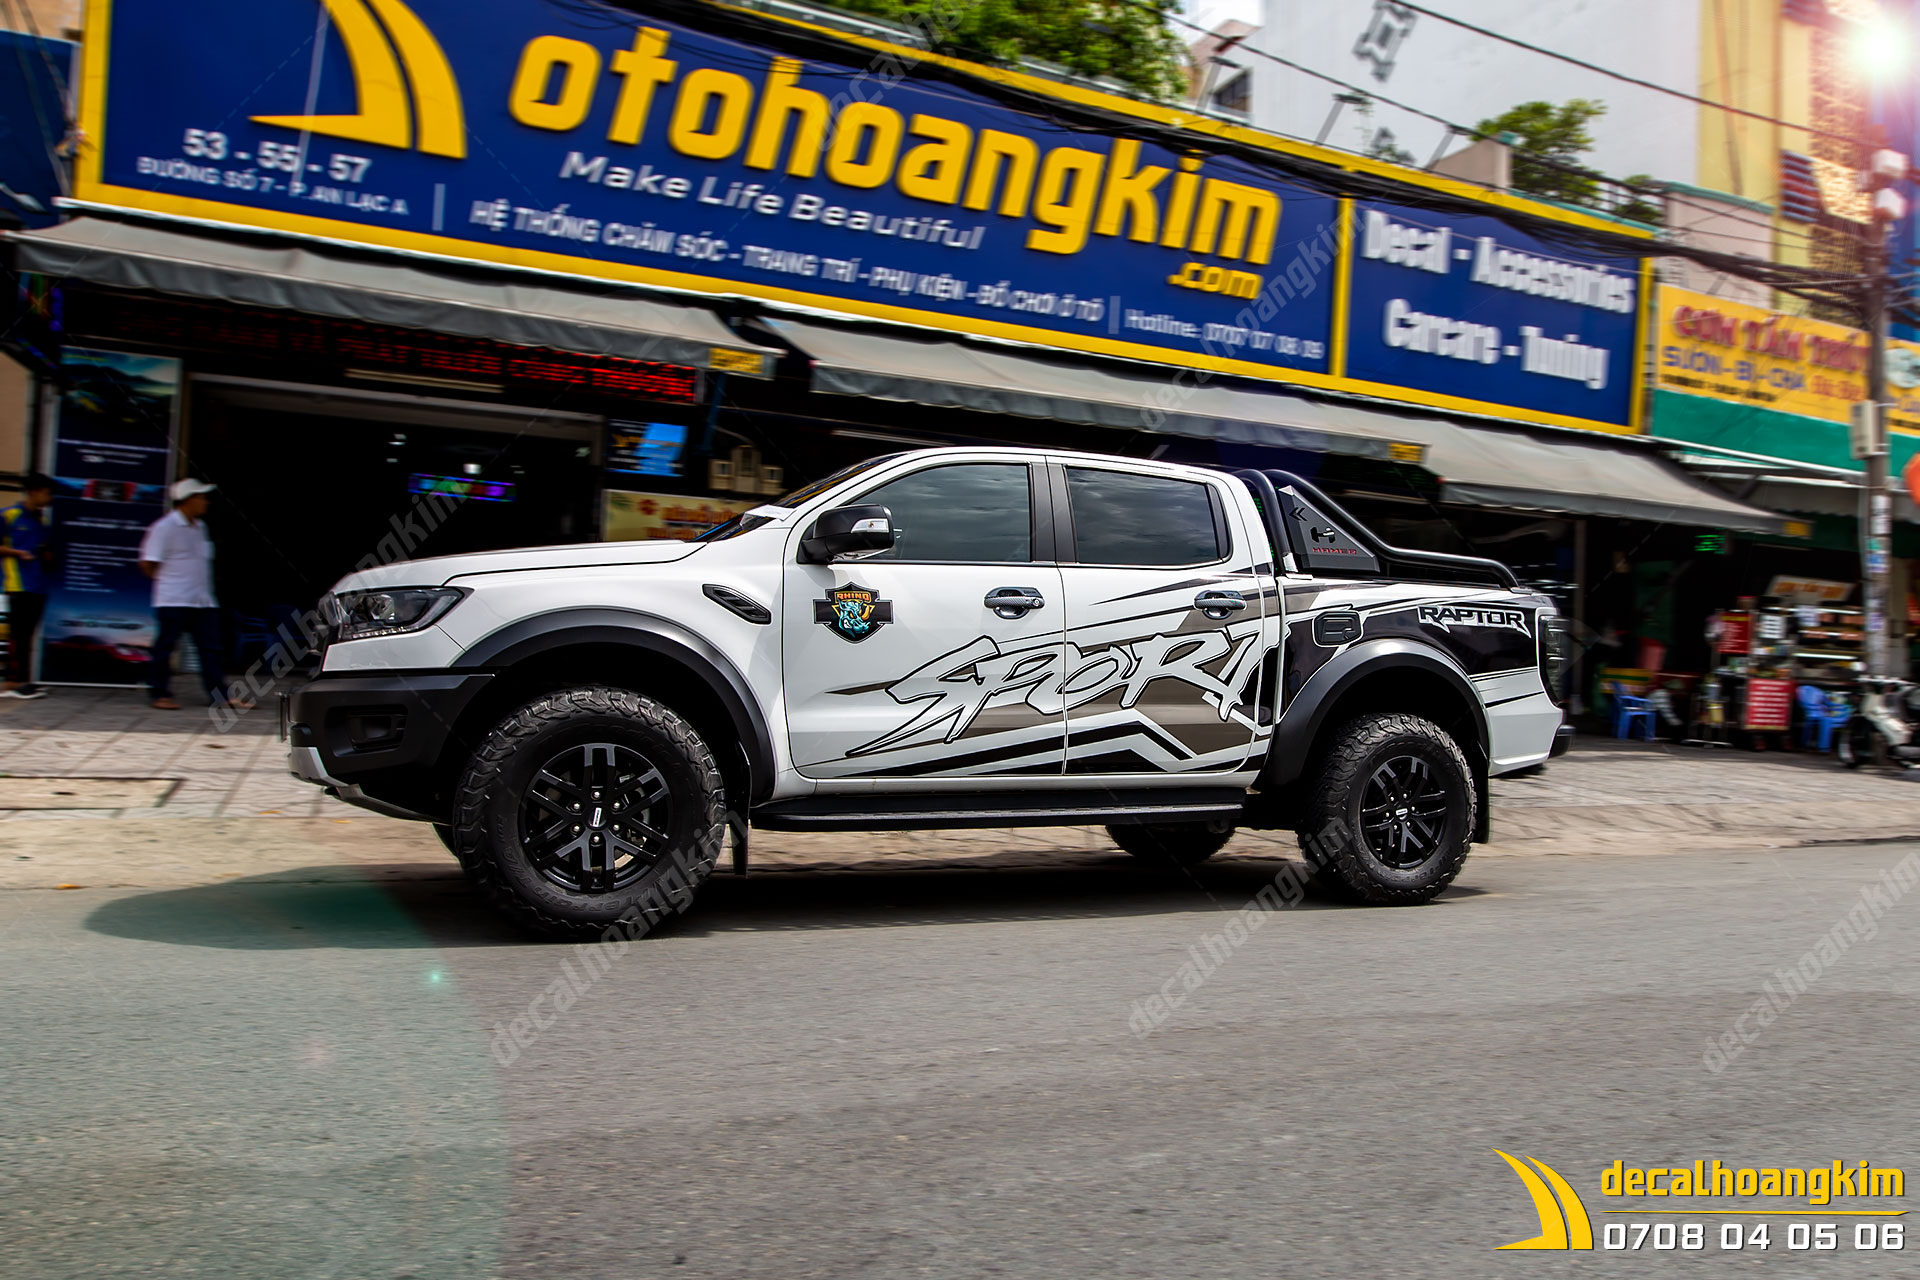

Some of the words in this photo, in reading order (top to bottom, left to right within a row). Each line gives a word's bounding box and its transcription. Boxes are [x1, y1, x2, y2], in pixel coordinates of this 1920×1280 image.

[183, 128, 228, 160] 53
[257, 140, 300, 172] 55
[328, 154, 372, 183] 57
[509, 27, 1282, 264] otohoangkim
[559, 151, 691, 198] Make
[697, 176, 784, 215] Life
[789, 193, 986, 250] Beautiful
[469, 199, 510, 231] HỆ
[513, 204, 601, 242] THỐNG
[602, 221, 677, 253] CHĂM
[676, 232, 729, 261] SÓC
[742, 245, 819, 276] TRANG
[821, 258, 862, 283] TRÍ
[869, 266, 915, 296] PHỤ
[915, 273, 968, 301] KIỆN
[1168, 262, 1264, 299] .com
[1361, 209, 1452, 274] Decal
[1469, 236, 1636, 315] Accessories
[1383, 298, 1502, 365] Carcare
[1518, 325, 1610, 390] Tuning
[836, 593, 869, 601] RHINO
[1417, 605, 1532, 638] RAPTOR
